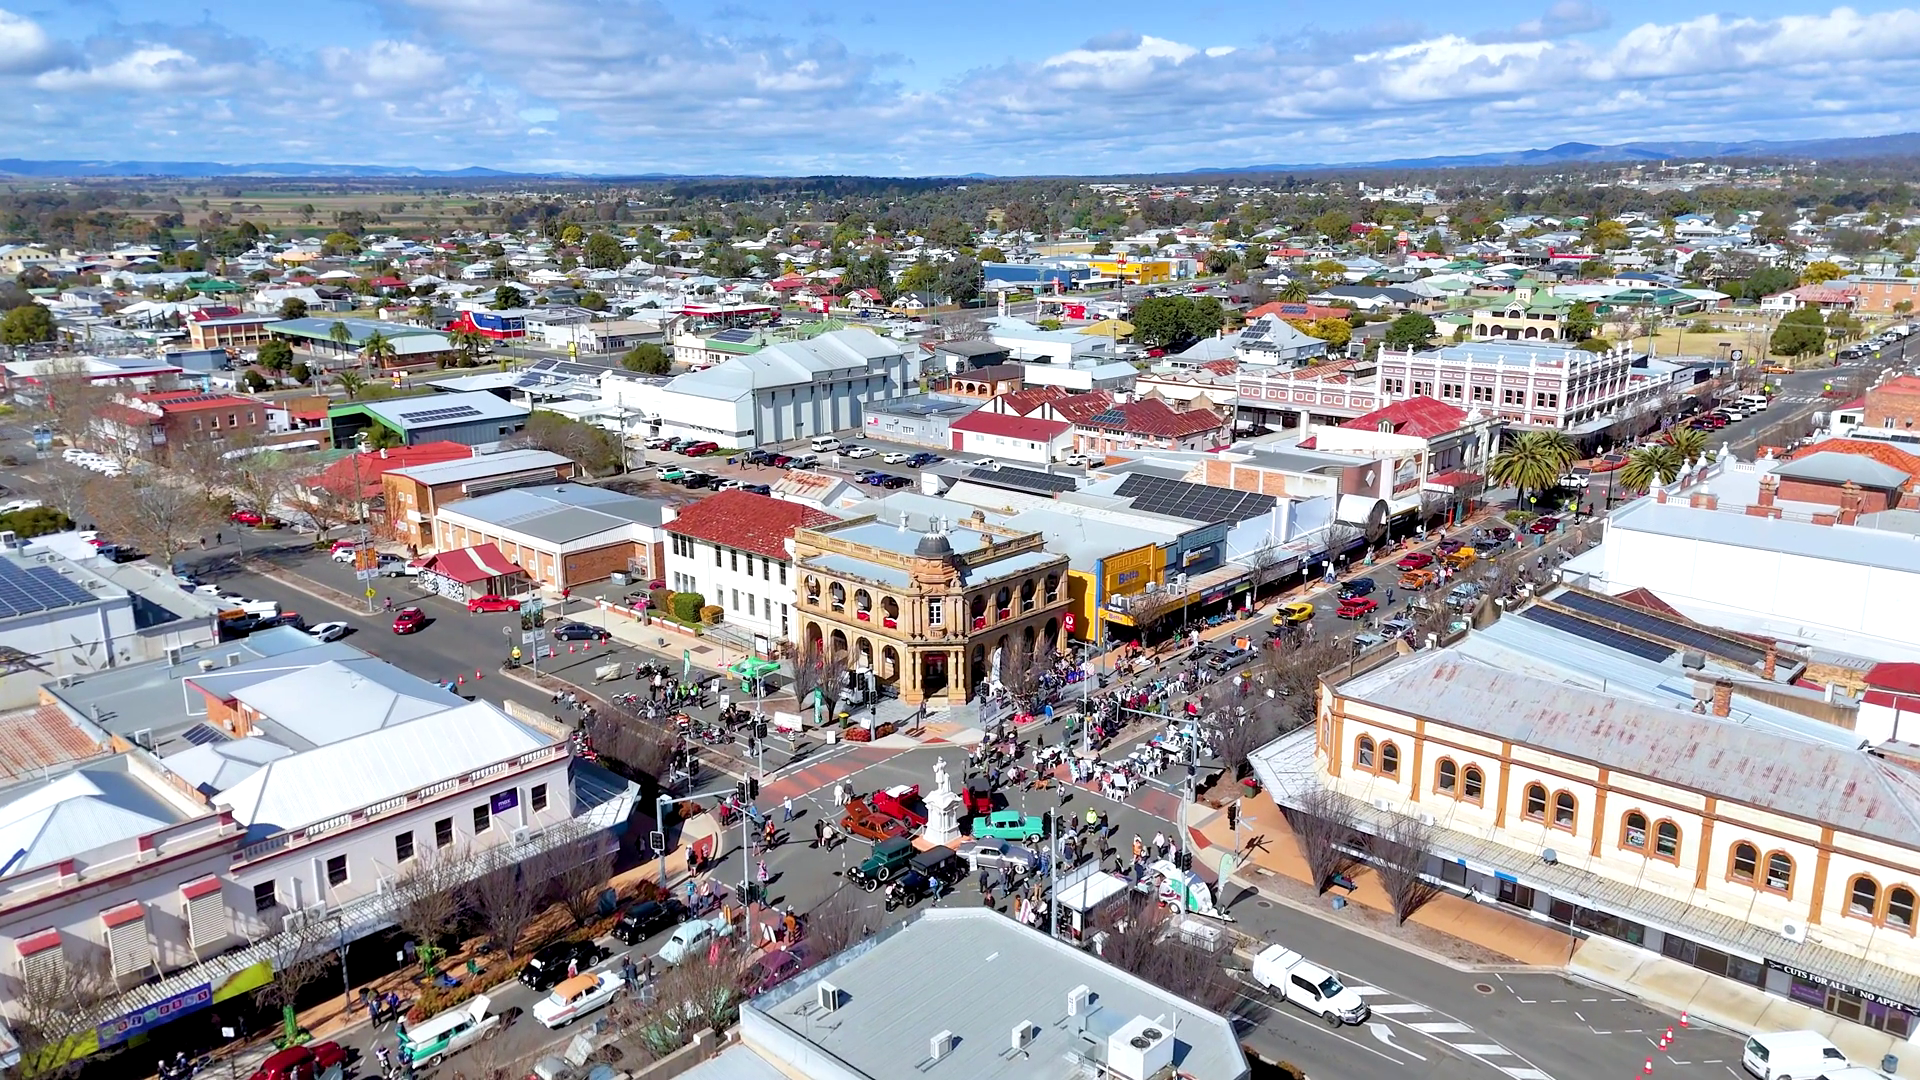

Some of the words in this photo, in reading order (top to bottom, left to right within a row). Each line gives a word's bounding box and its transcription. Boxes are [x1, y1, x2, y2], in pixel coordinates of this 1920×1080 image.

[1784, 966, 1808, 979] CUTS
[1809, 973, 1828, 986] FOR
[1829, 981, 1848, 993] ALL
[1860, 990, 1875, 1001] NO
[1876, 998, 1903, 1011] APPT
